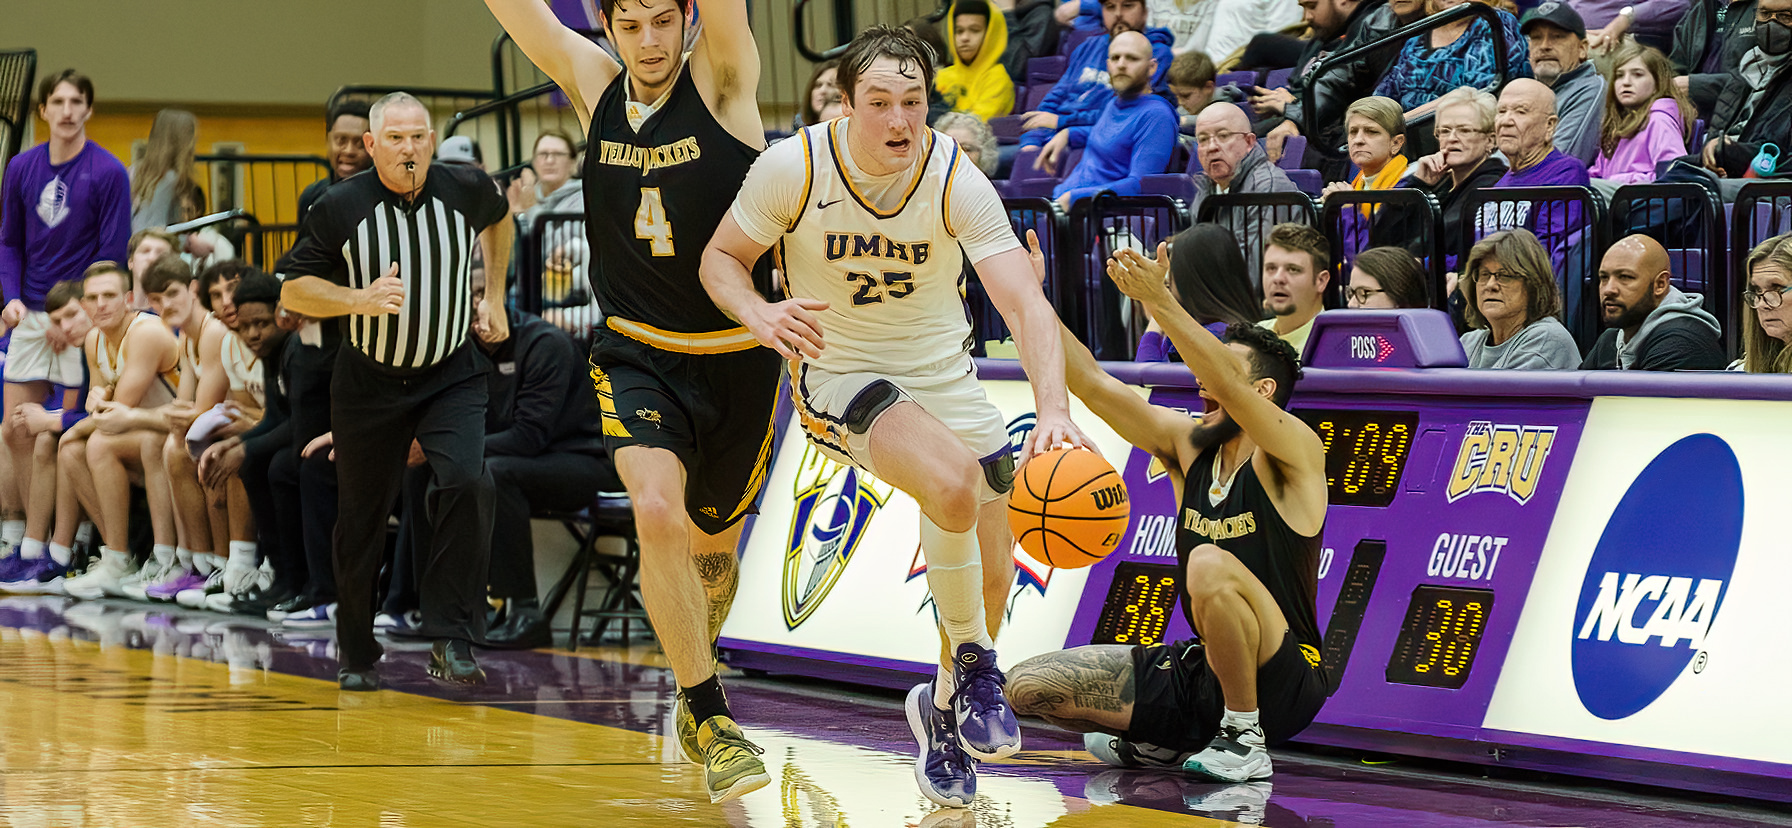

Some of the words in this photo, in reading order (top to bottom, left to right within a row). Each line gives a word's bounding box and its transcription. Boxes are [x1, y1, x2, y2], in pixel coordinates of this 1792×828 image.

[634, 187, 675, 257] 4
[845, 270, 916, 307] 25
[1351, 336, 1376, 359] POSS
[1467, 421, 1491, 436] THE
[1446, 424, 1558, 506] CRU
[1129, 515, 1178, 557] HOM
[1427, 532, 1509, 580] GUEST
[1115, 575, 1175, 645] 36
[1415, 600, 1483, 676] 30
[1577, 571, 1723, 650] NCAA
